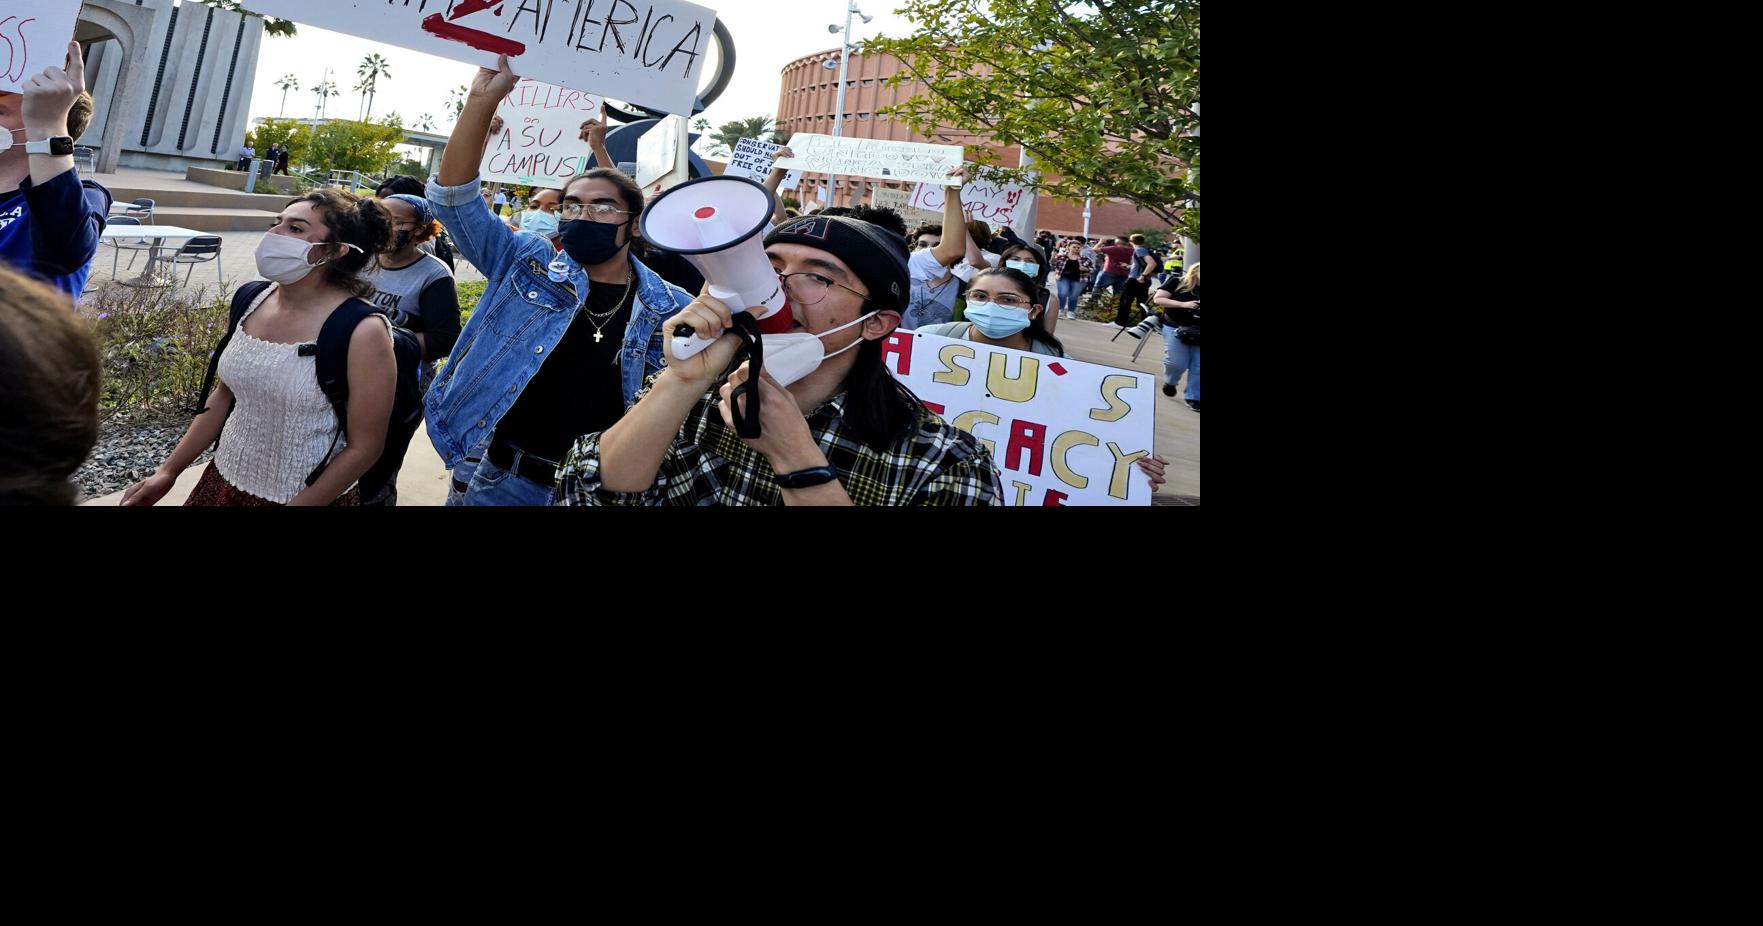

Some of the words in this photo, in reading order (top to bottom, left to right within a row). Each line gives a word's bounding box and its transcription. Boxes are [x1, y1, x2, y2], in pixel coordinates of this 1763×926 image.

[736, 144, 763, 155] SHOULD
[734, 152, 751, 161] OUT
[731, 159, 753, 170] FREE
[967, 184, 1004, 199] MY
